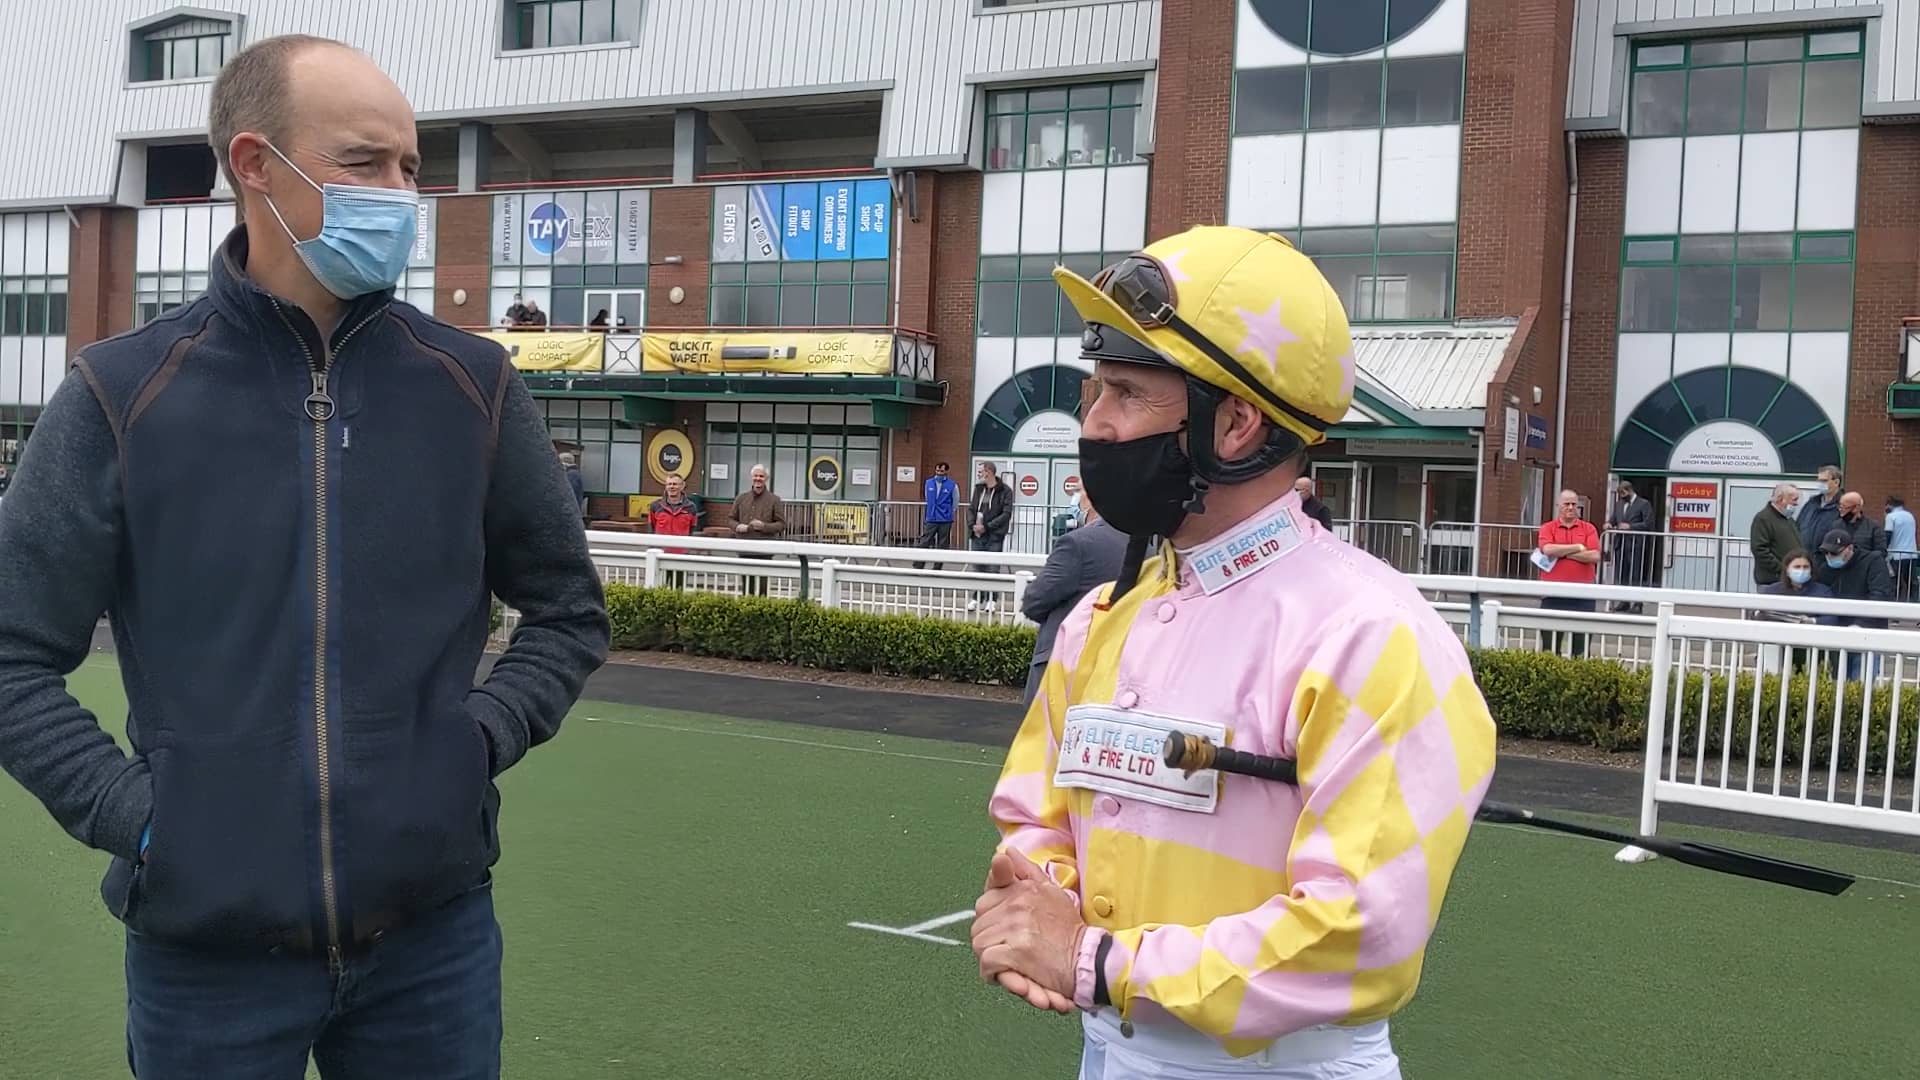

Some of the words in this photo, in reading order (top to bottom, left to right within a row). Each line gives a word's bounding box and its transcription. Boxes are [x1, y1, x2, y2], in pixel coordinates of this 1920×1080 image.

[528, 216, 612, 240] TAYLEX
[723, 203, 736, 244] EVENTS
[801, 209, 811, 231] SHOP
[860, 206, 870, 232] SHOPS
[873, 203, 884, 233] POP-UP
[416, 204, 428, 260] EXHIBITIONS
[537, 340, 564, 349] LOGIC
[669, 341, 699, 351] CLICK
[701, 341, 713, 351] IT.
[817, 341, 848, 351] LOGIC
[528, 352, 571, 362] COMPACT
[670, 353, 697, 363] VAPE
[699, 353, 711, 363] IT.
[807, 354, 855, 364] COMPACT
[1676, 487, 1712, 496] Jockey
[1677, 502, 1710, 512] ENTRY
[1675, 520, 1710, 531] Jockey
[1195, 550, 1227, 574] ELITE
[1226, 515, 1291, 558] ELECTRICAL
[1221, 564, 1232, 577] &
[1233, 551, 1259, 571] FIRE
[1260, 539, 1280, 557] LTD
[1085, 727, 1121, 748] ELITE
[1082, 746, 1091, 764] &
[1098, 749, 1124, 769] FIRE
[1128, 754, 1155, 776] LTD
